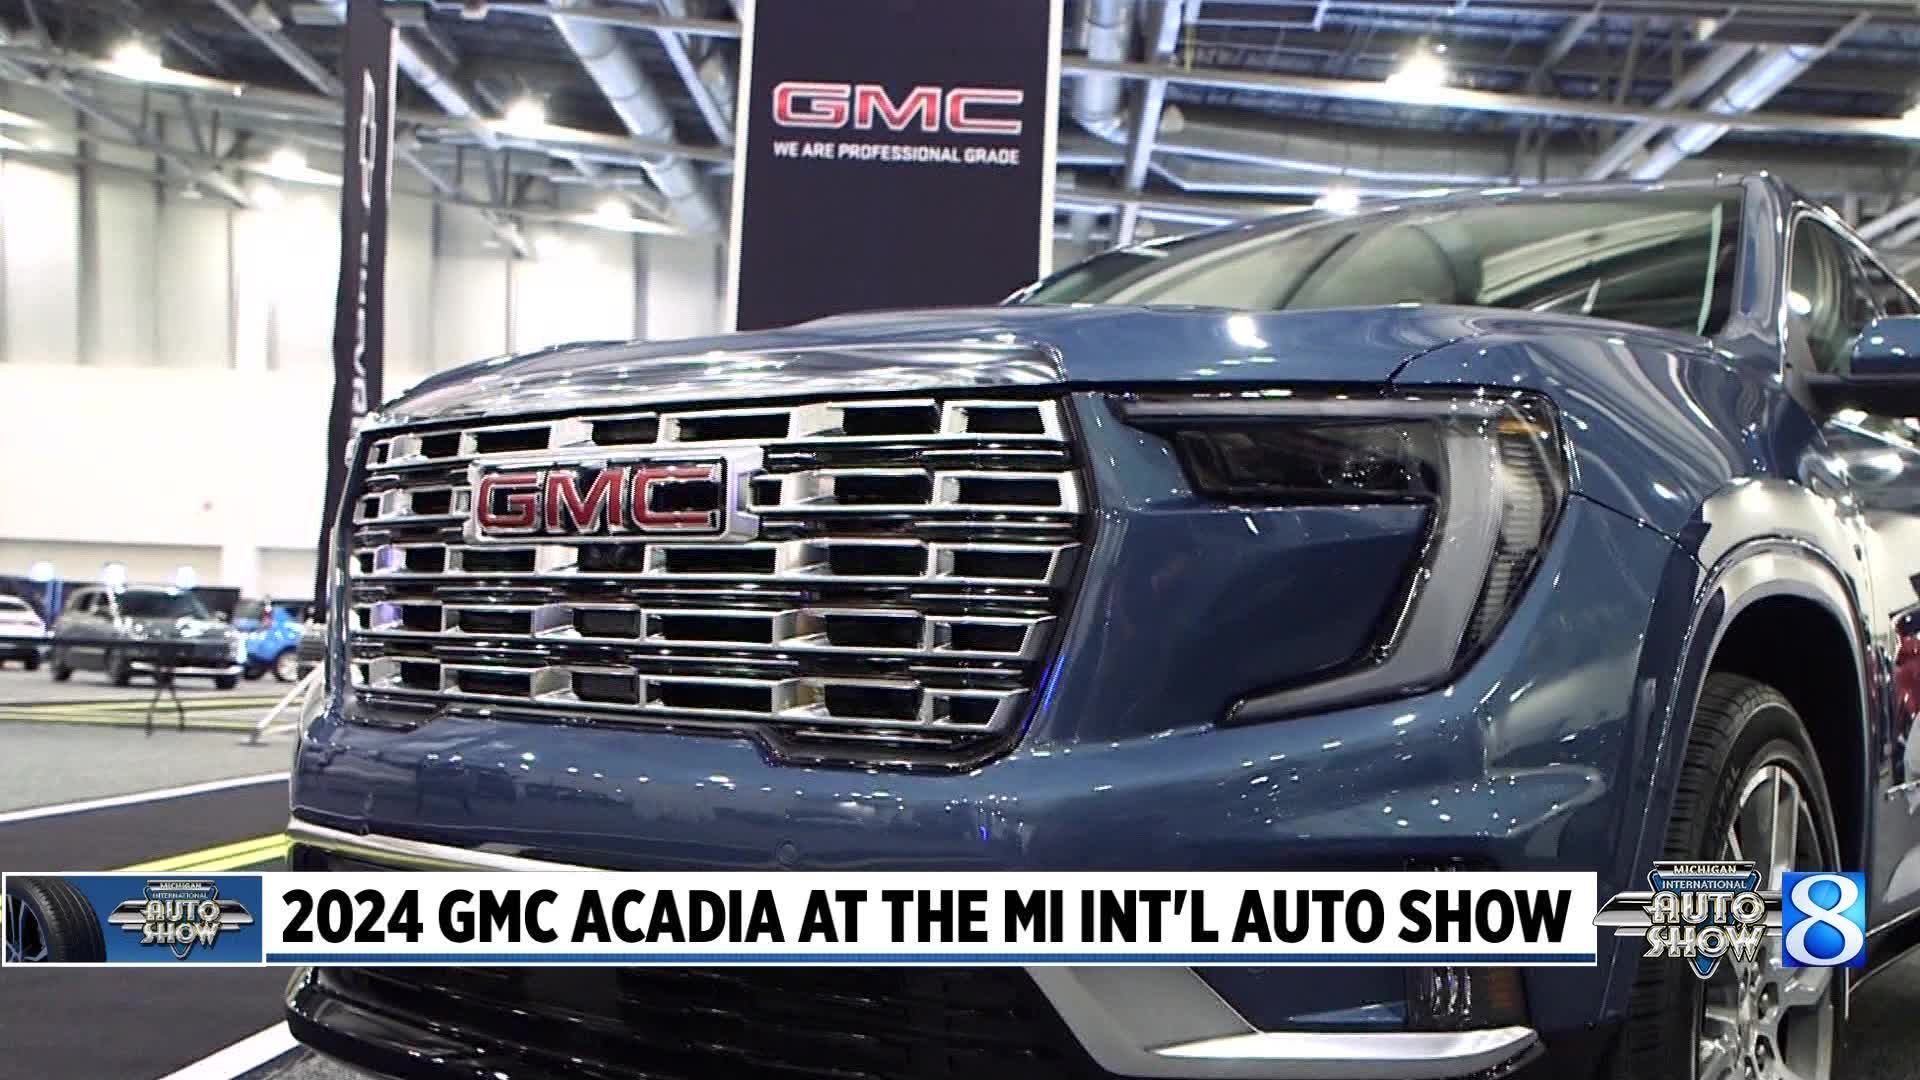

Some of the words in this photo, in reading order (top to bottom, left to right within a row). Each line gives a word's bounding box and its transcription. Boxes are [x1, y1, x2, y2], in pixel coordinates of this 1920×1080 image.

[773, 82, 1023, 134] GMC
[773, 141, 799, 158] WE
[801, 142, 835, 160] ARE
[838, 143, 961, 163] PROFESSIONAL
[964, 146, 1020, 165] GRADE
[478, 464, 721, 535] GMC
